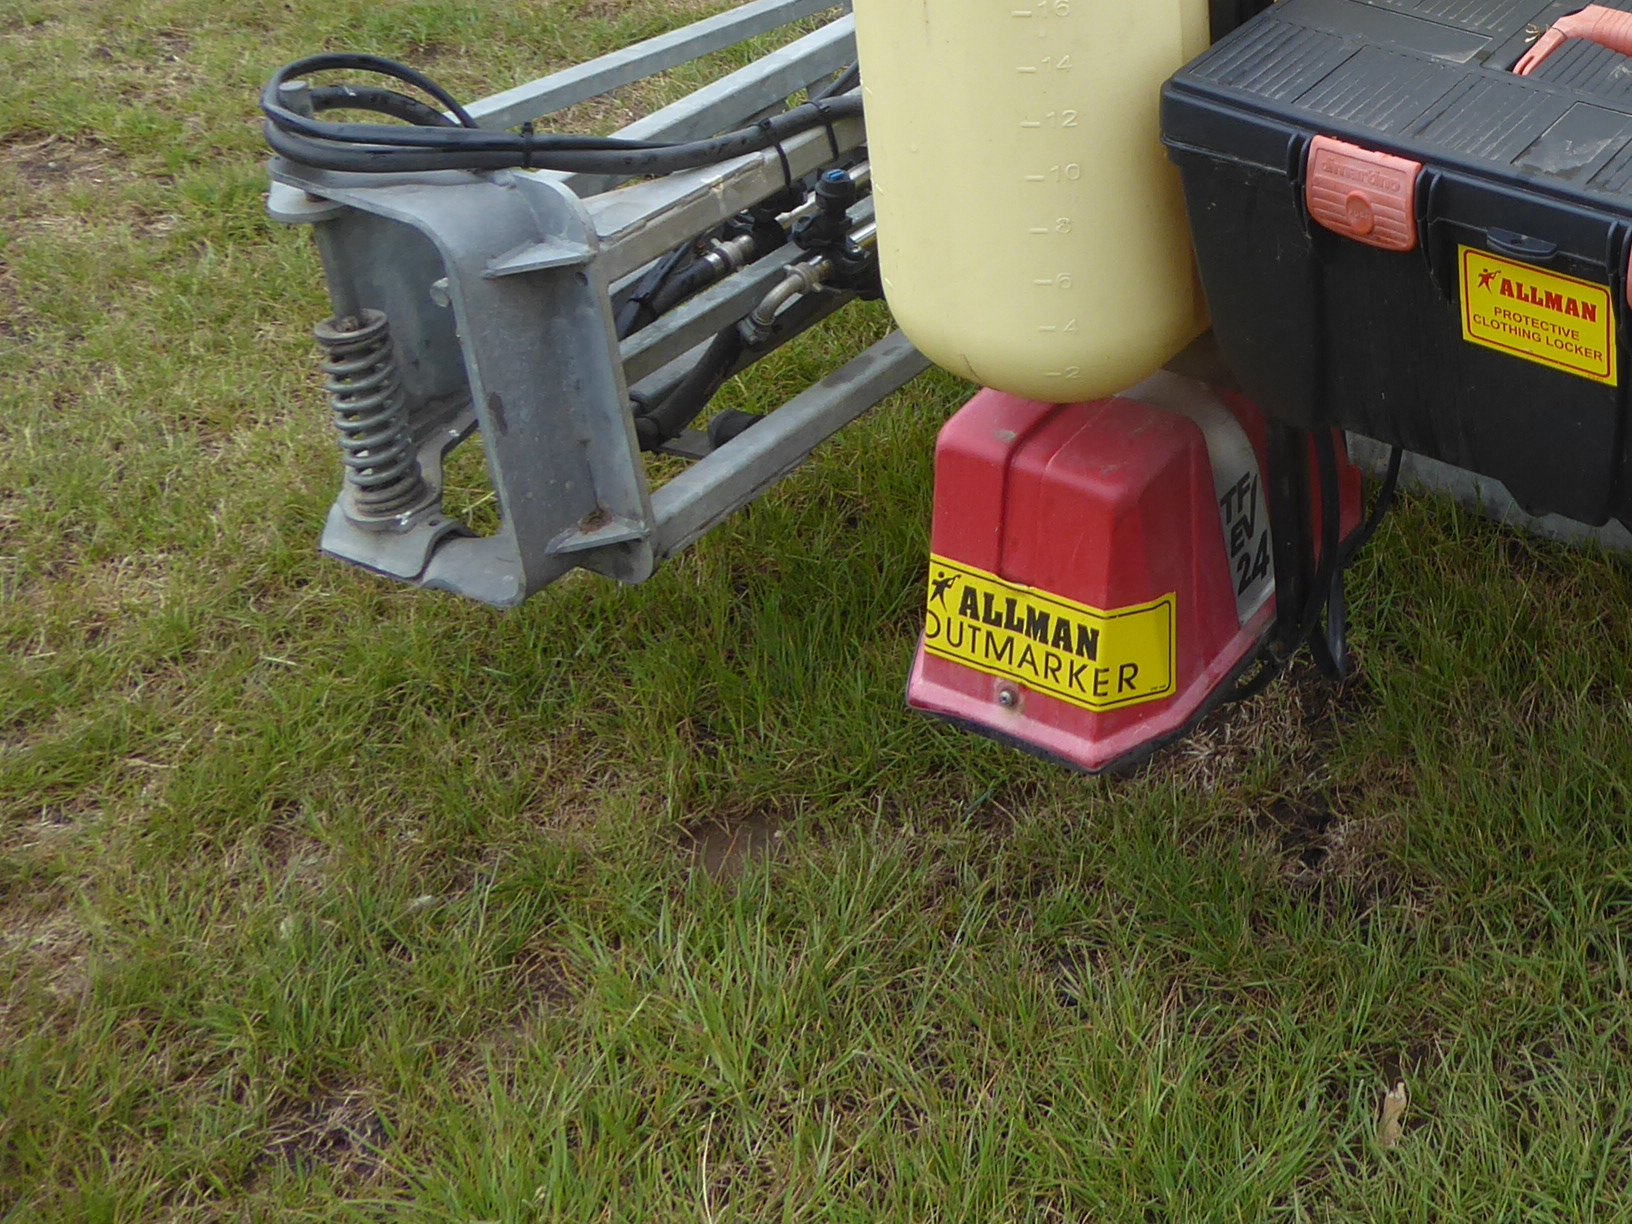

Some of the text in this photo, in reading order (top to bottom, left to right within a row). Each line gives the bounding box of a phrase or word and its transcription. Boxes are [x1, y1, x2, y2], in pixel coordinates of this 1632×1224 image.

[1040, 54, 1073, 74] 14
[1046, 109, 1079, 129] 12
[1050, 162, 1082, 183] 10
[1500, 277, 1597, 323] ALLMAN
[1473, 313, 1603, 362] CLOTHING LOCKER
[1494, 306, 1580, 341] PROTECTIVE
[1236, 528, 1270, 596] 24
[959, 585, 1101, 662] ALLMAN
[925, 610, 1140, 698] OUTMARKER
